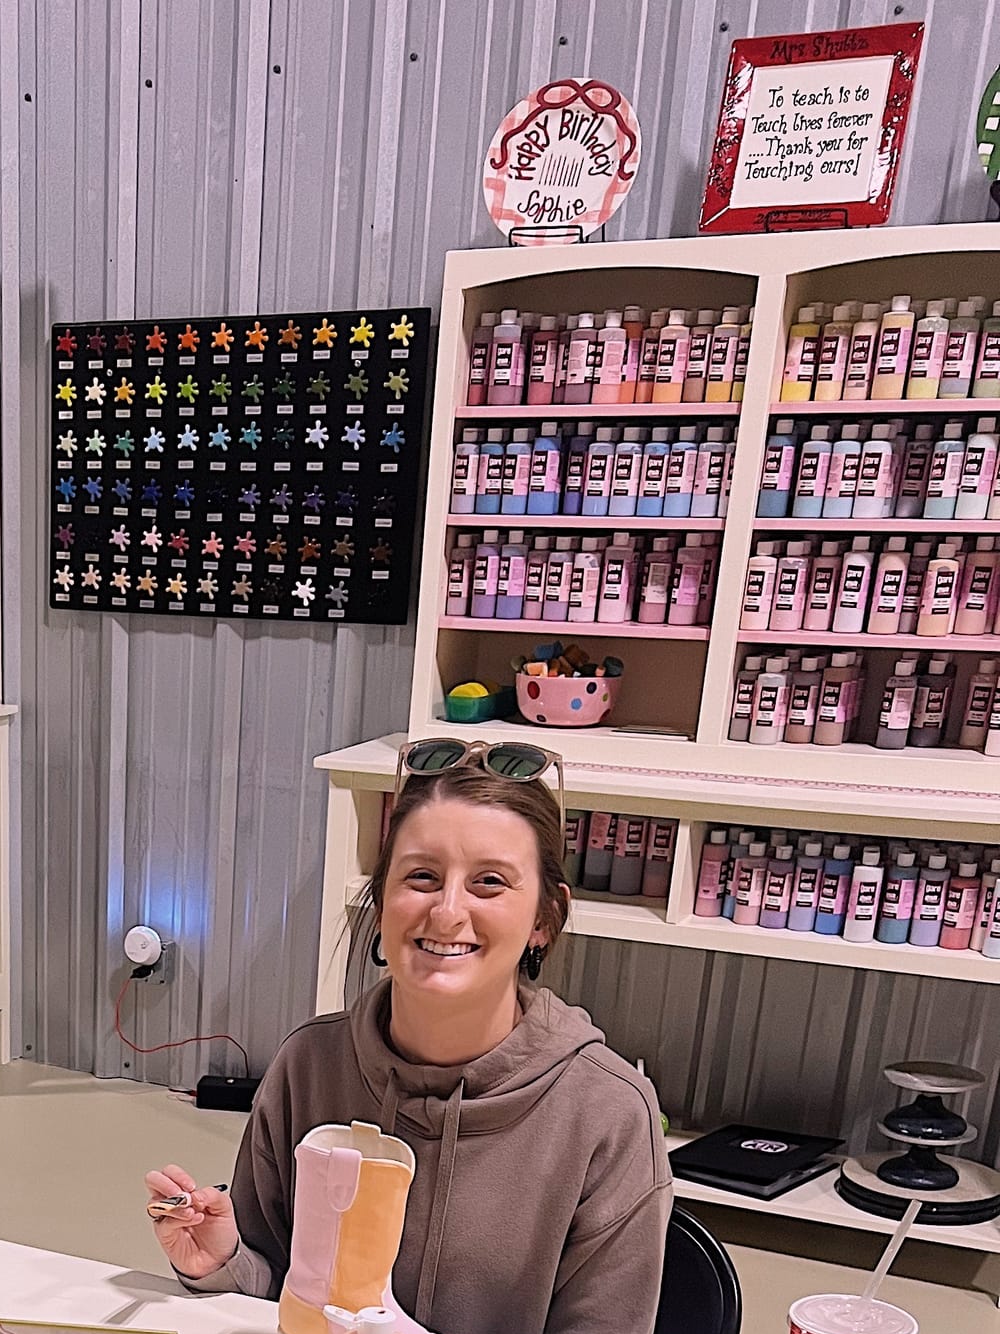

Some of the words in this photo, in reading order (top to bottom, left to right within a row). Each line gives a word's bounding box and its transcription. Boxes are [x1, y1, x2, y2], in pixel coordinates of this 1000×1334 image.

[768, 86, 784, 108] To
[792, 87, 834, 107] teach
[855, 85, 870, 101] to
[752, 114, 787, 134] Touch
[793, 112, 823, 131] lives
[827, 111, 873, 129] forever
[508, 114, 550, 180] Happy
[558, 108, 617, 177] Birthday
[816, 138, 843, 157] you
[847, 131, 868, 151] for
[744, 160, 813, 182] Touching
[820, 153, 861, 176] ours!
[517, 190, 587, 223] Sophie
